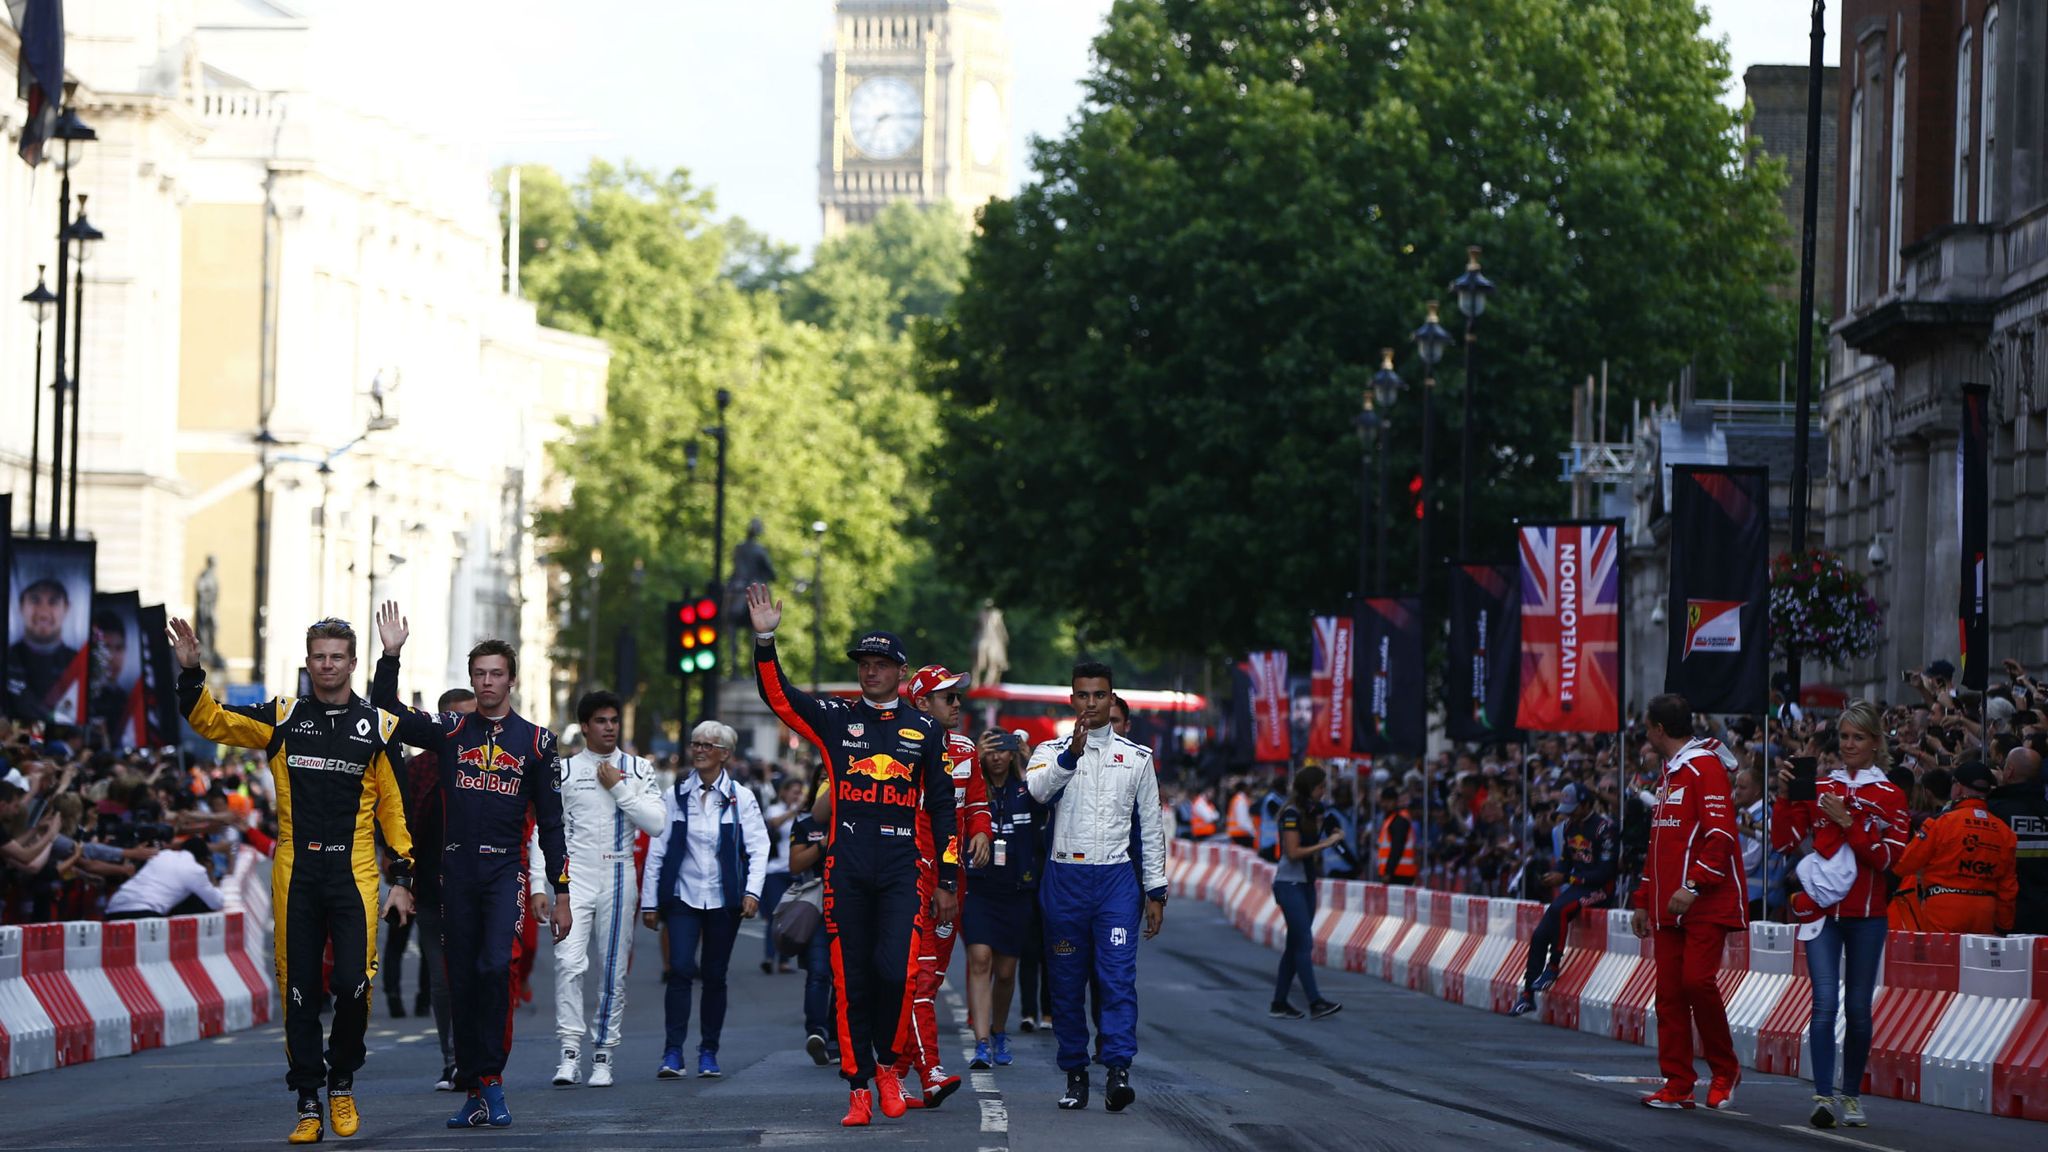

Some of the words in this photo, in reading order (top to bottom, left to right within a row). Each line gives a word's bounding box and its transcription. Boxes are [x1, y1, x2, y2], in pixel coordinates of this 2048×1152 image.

[291, 727, 322, 736] INFINITI
[349, 735, 373, 744] RENAULT
[842, 740, 862, 748] Mobil
[296, 757, 324, 769] Castrol
[324, 758, 366, 775] EDGE
[455, 769, 485, 790] Red
[487, 773, 521, 796] Bull
[839, 780, 878, 803] Red
[882, 784, 917, 807] Bull
[896, 827, 912, 837] MAX
[325, 844, 346, 852] NICO
[823, 855, 835, 894] Red
[1959, 860, 1996, 875] NGK
[823, 896, 838, 934] Bull
